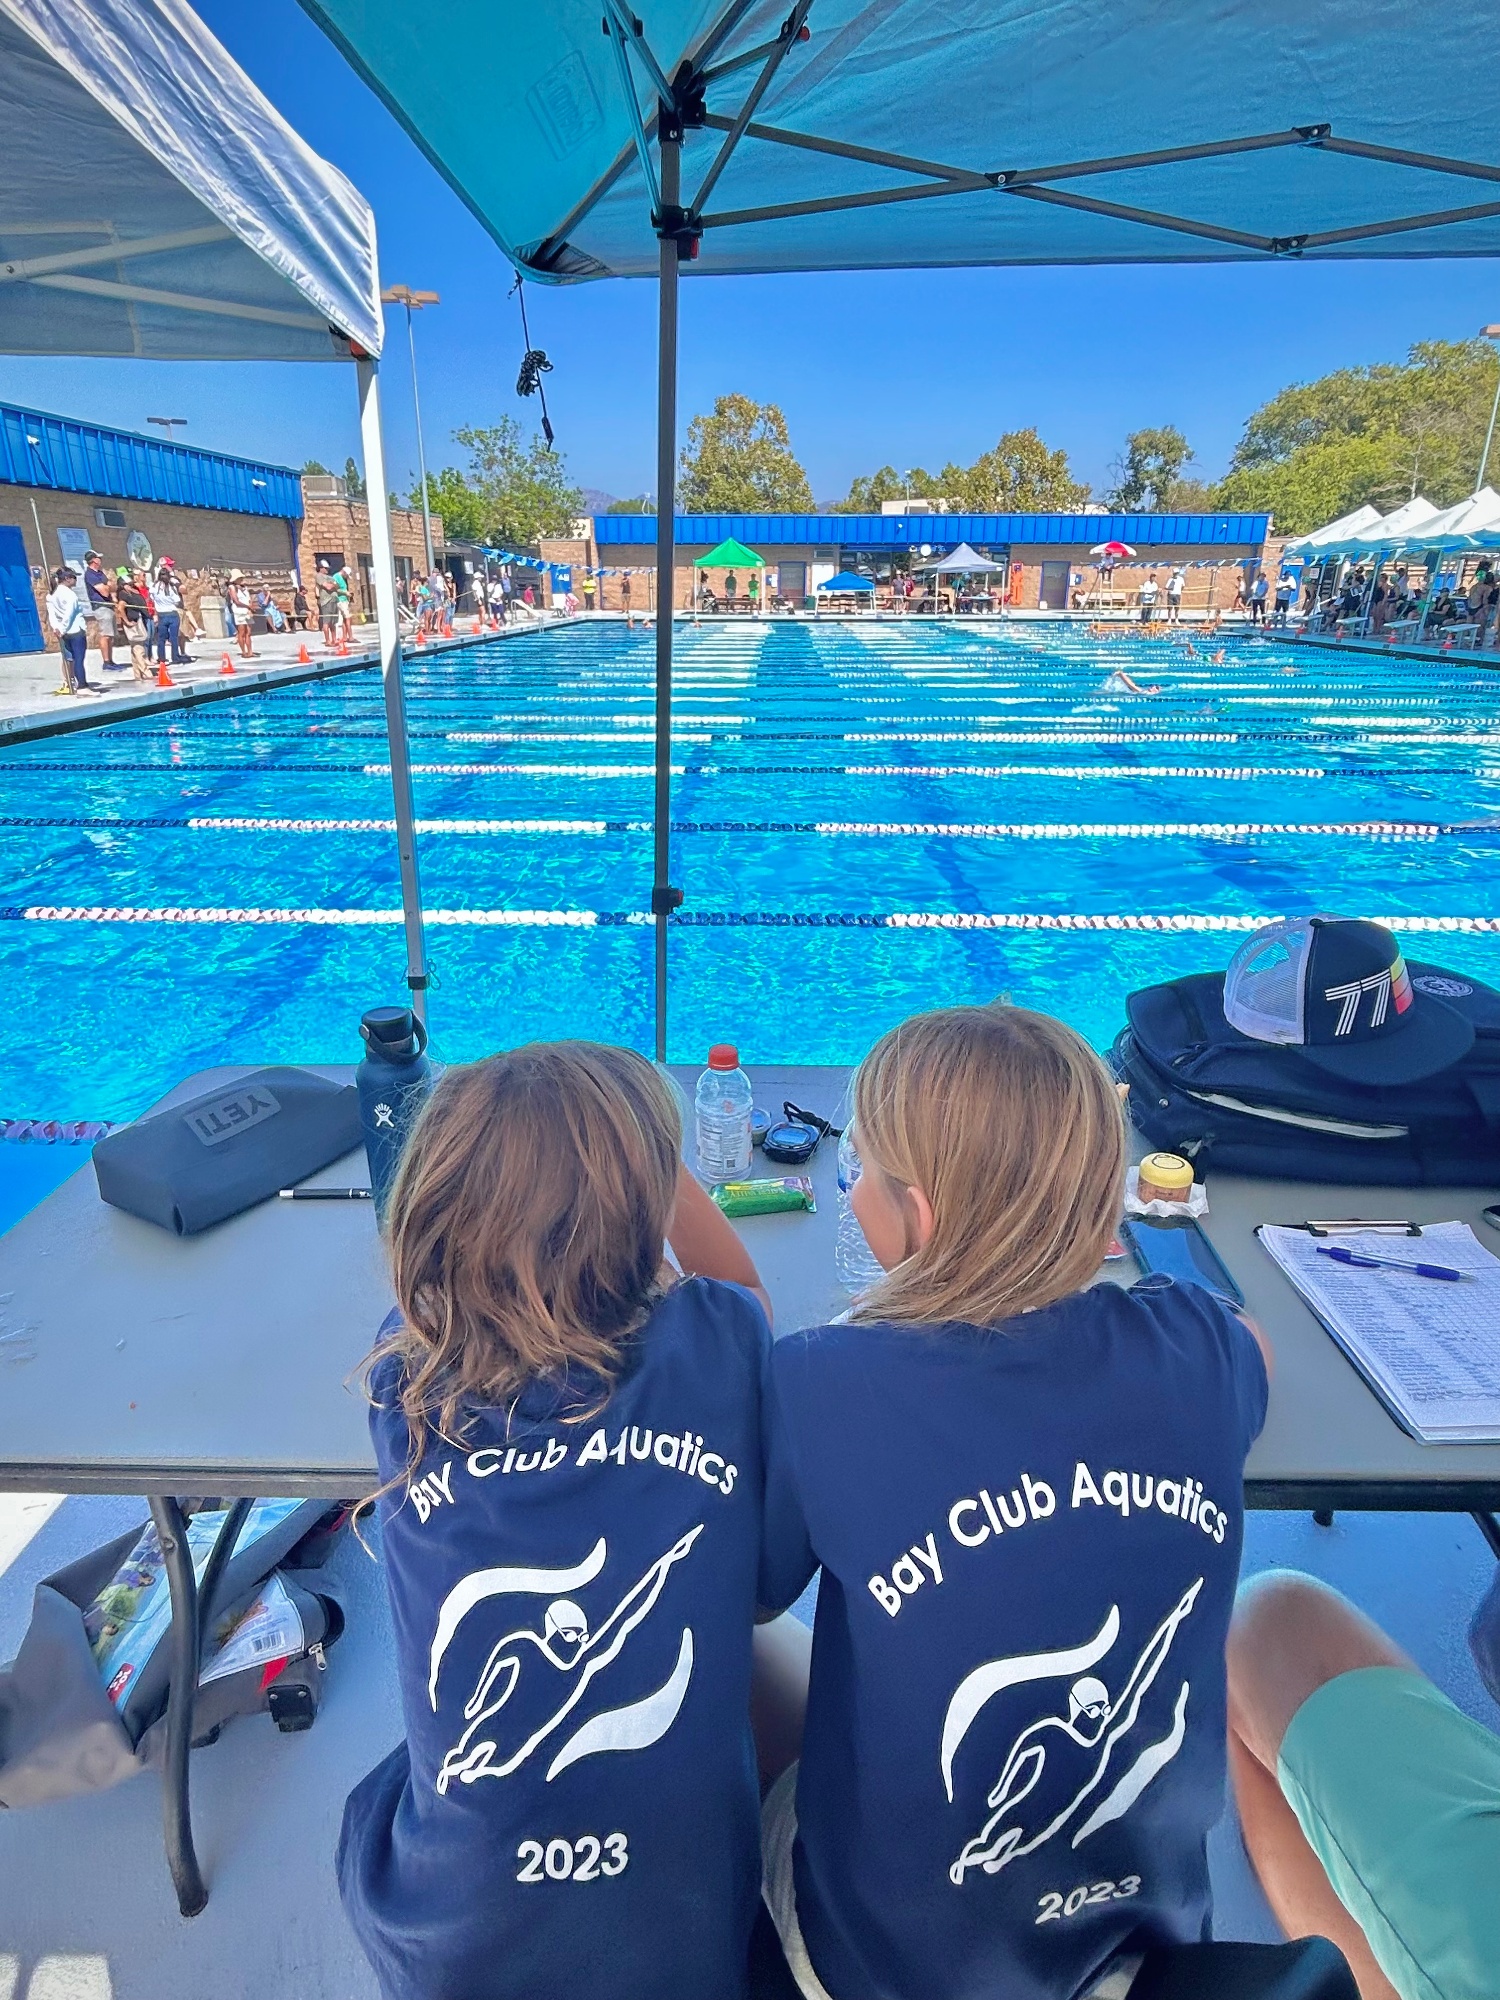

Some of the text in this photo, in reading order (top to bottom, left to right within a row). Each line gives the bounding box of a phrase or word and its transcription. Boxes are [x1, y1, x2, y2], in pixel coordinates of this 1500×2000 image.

[1324, 968, 1391, 1036] 77
[195, 1094, 271, 1137] YETI
[466, 1437, 568, 1478] Club
[867, 1462, 1228, 1618] Bay Club Aquatics
[516, 1832, 629, 1882] 2023
[1034, 1875, 1141, 1925] 2023
